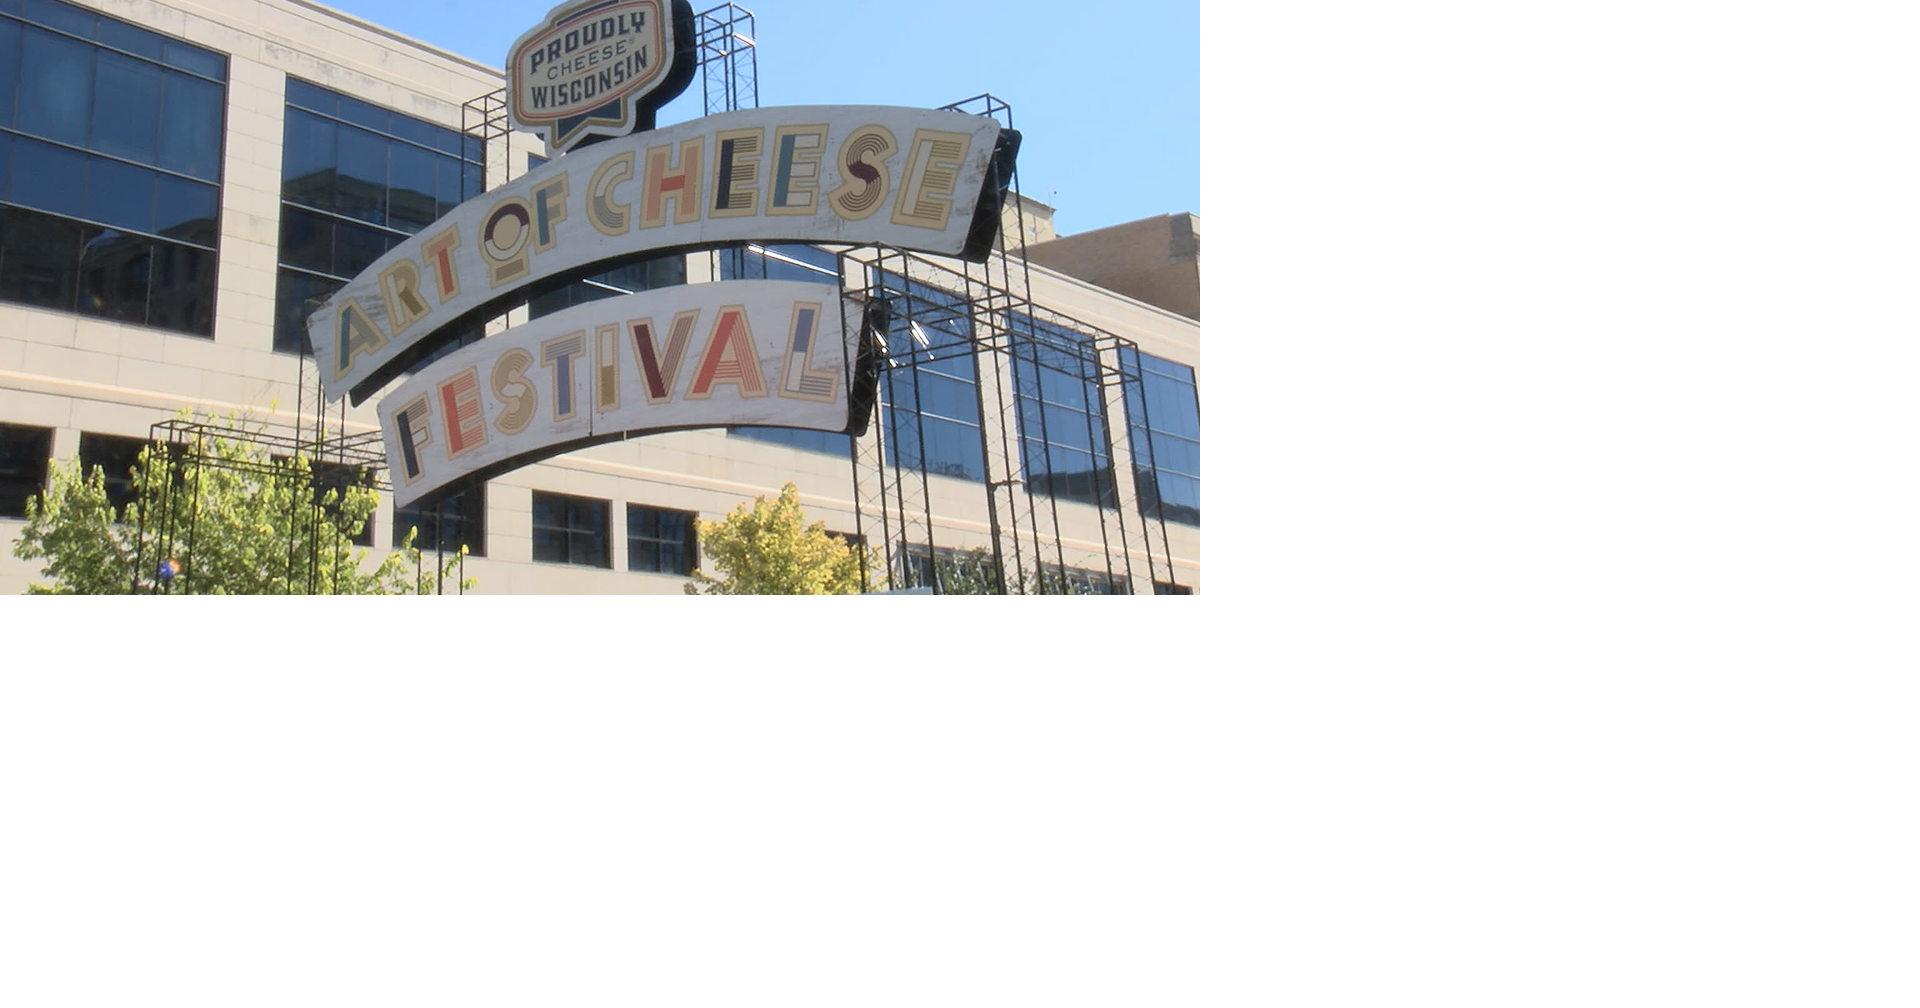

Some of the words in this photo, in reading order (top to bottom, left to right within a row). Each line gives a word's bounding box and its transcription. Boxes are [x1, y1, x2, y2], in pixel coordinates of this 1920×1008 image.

[530, 11, 646, 75] PROUDLY
[531, 44, 648, 109] WISCONSIN
[334, 223, 461, 382] ART
[478, 171, 570, 289] OF
[585, 123, 972, 236] CHEESE
[392, 301, 841, 486] FESTIVAL
